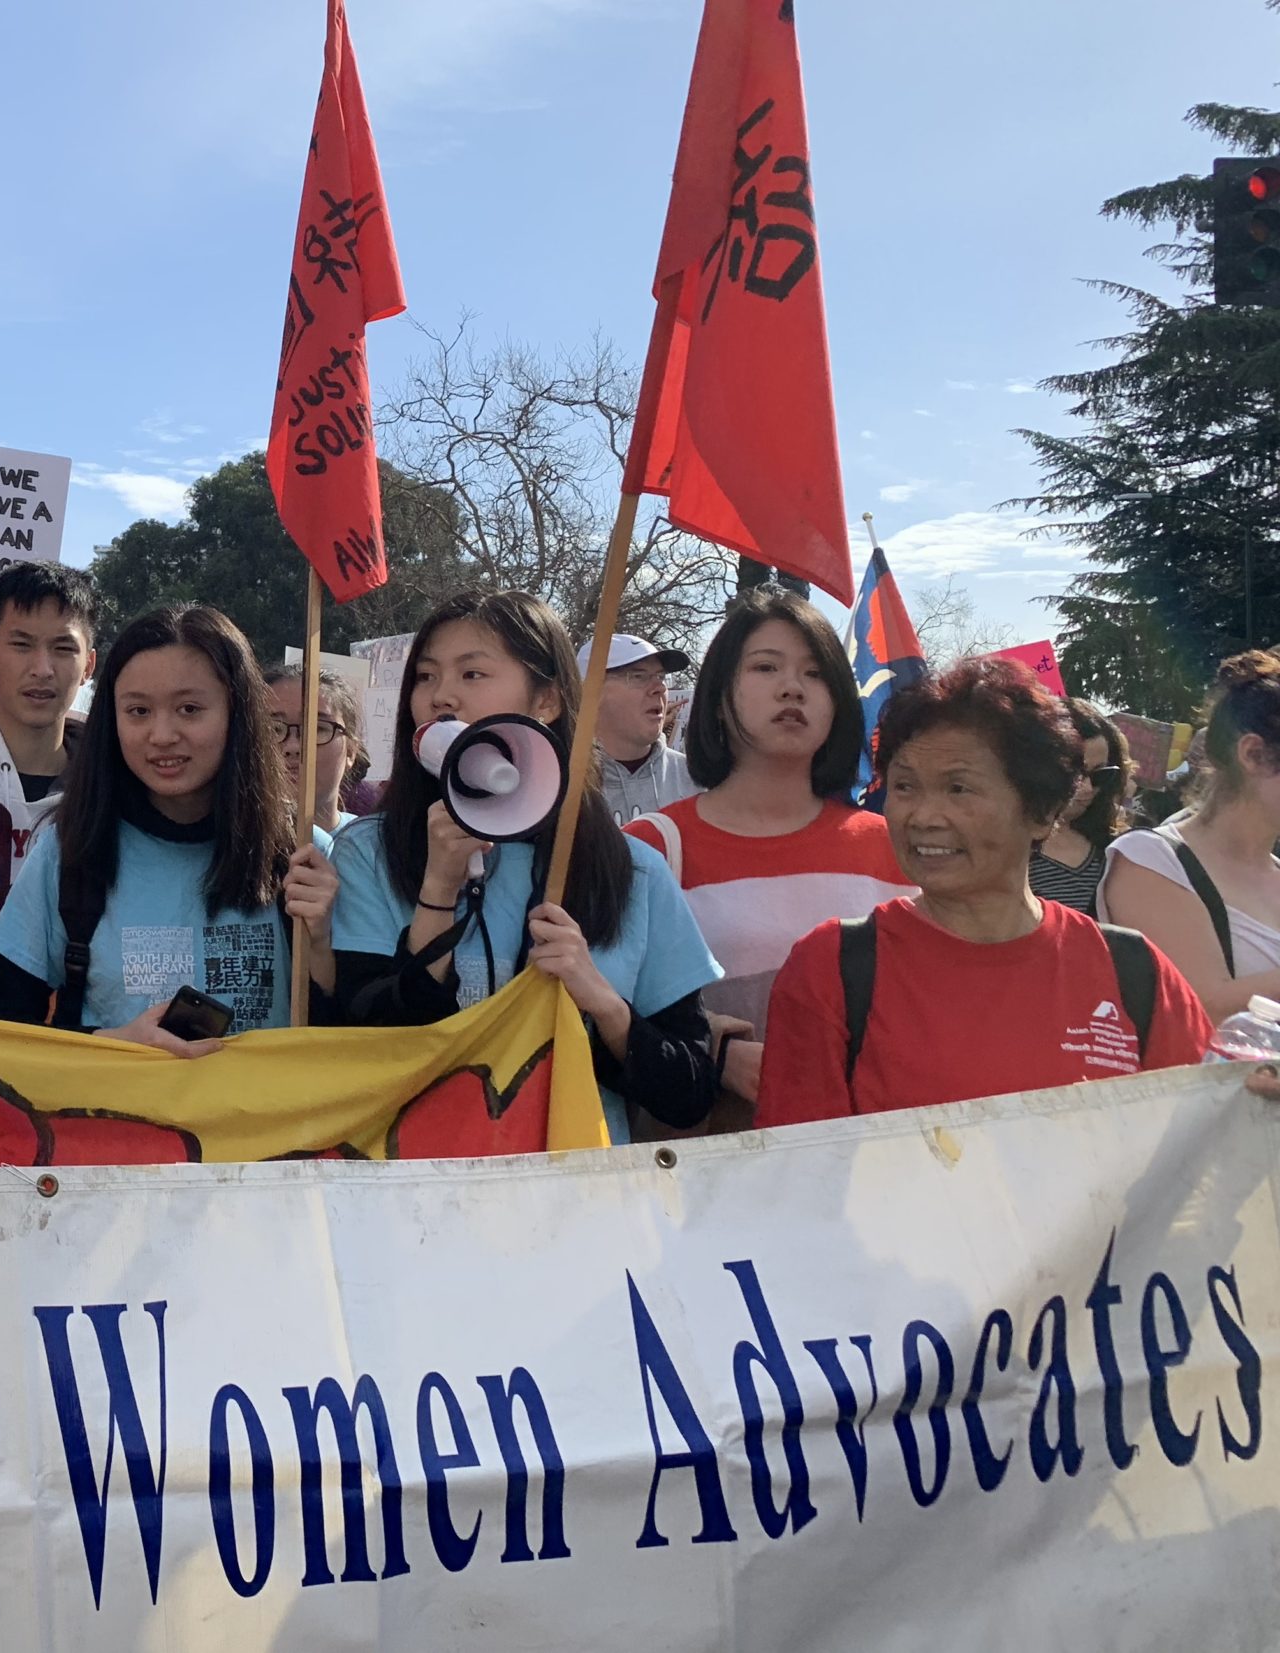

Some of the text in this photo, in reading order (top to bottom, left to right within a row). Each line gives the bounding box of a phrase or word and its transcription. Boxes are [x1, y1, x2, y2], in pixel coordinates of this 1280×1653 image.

[289, 346, 358, 427] JUST
[0, 466, 40, 492] WE
[32, 501, 54, 523] A
[122, 954, 194, 964] YOUTH BUILD
[122, 963, 196, 974] IMMIGRANT
[124, 974, 168, 986] POWER
[33, 1299, 572, 1611] Women
[625, 1226, 1262, 1549] Advocates
